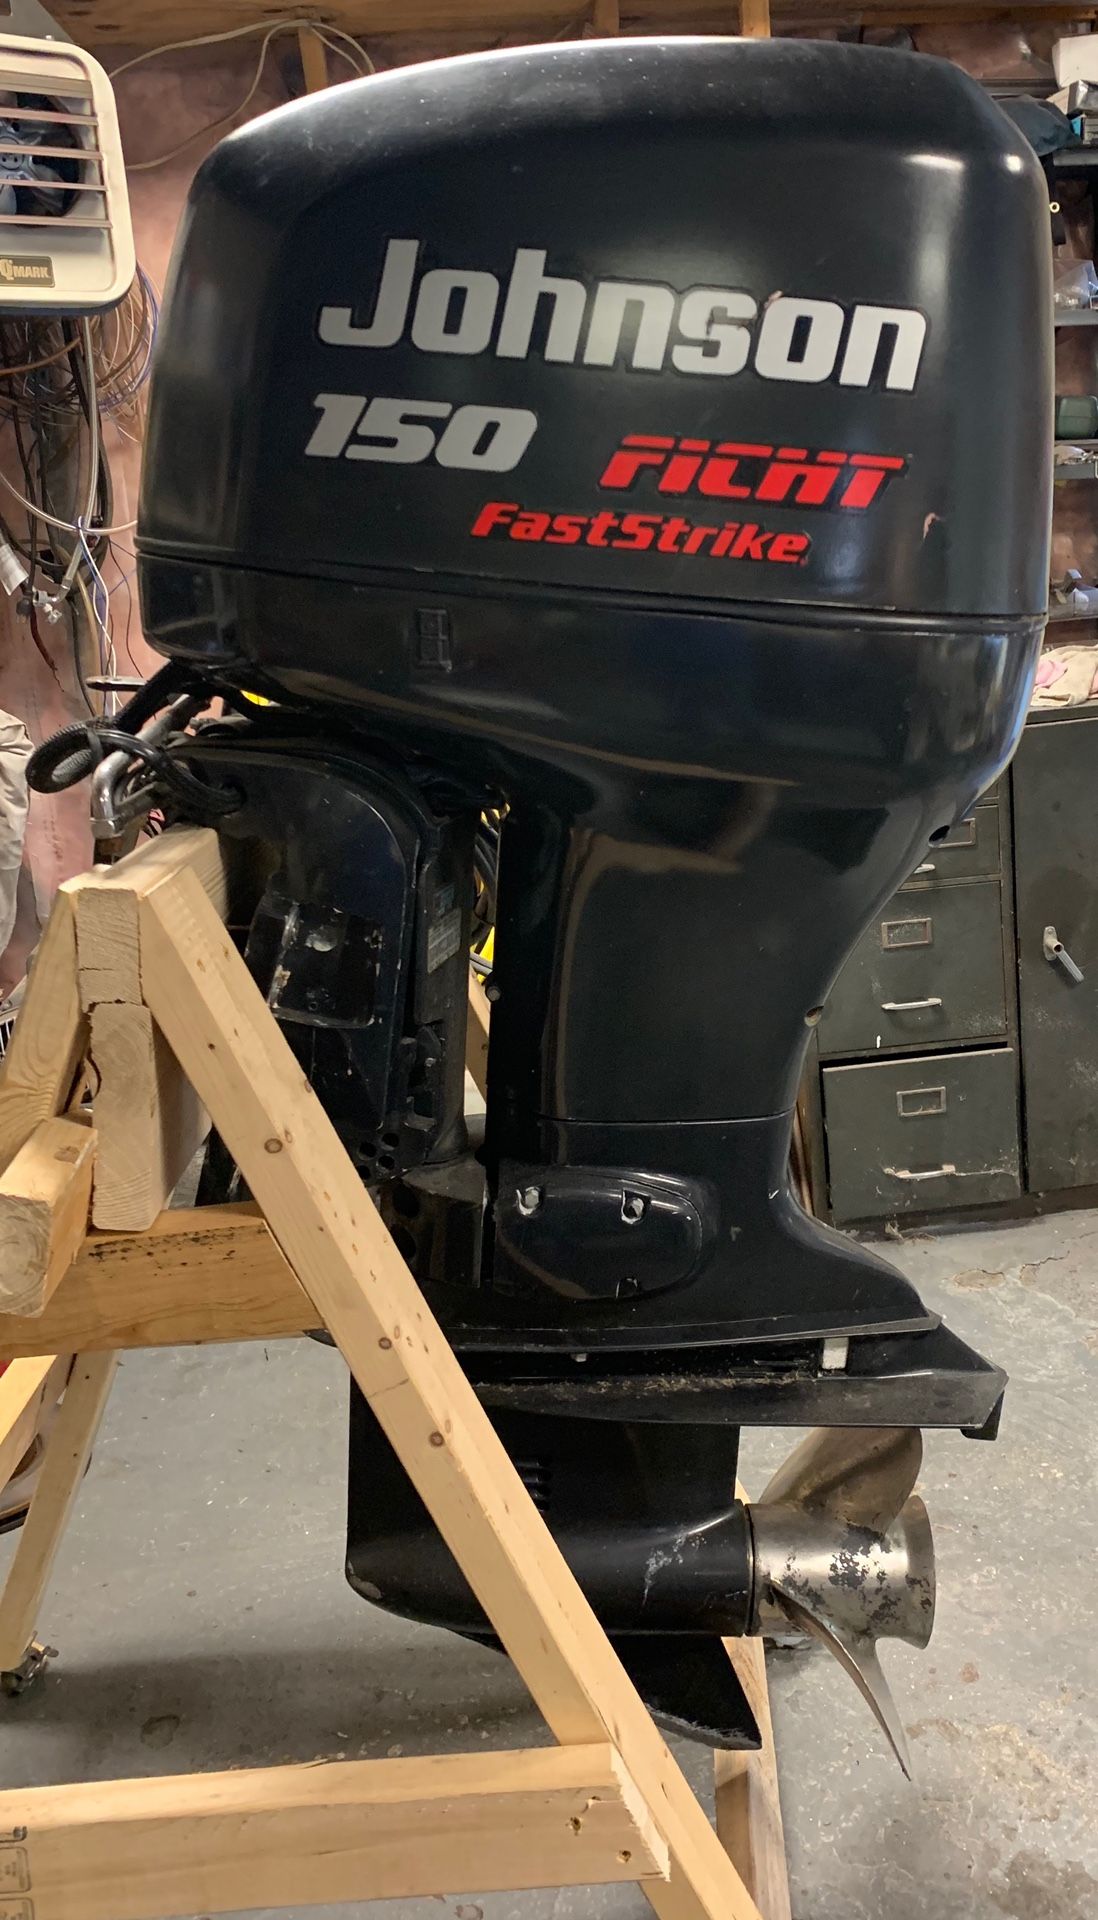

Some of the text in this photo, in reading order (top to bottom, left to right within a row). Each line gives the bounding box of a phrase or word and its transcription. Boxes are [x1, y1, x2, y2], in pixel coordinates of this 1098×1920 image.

[317, 239, 928, 391] Johnson
[304, 393, 539, 473] 150
[471, 502, 810, 563] FastStrike
